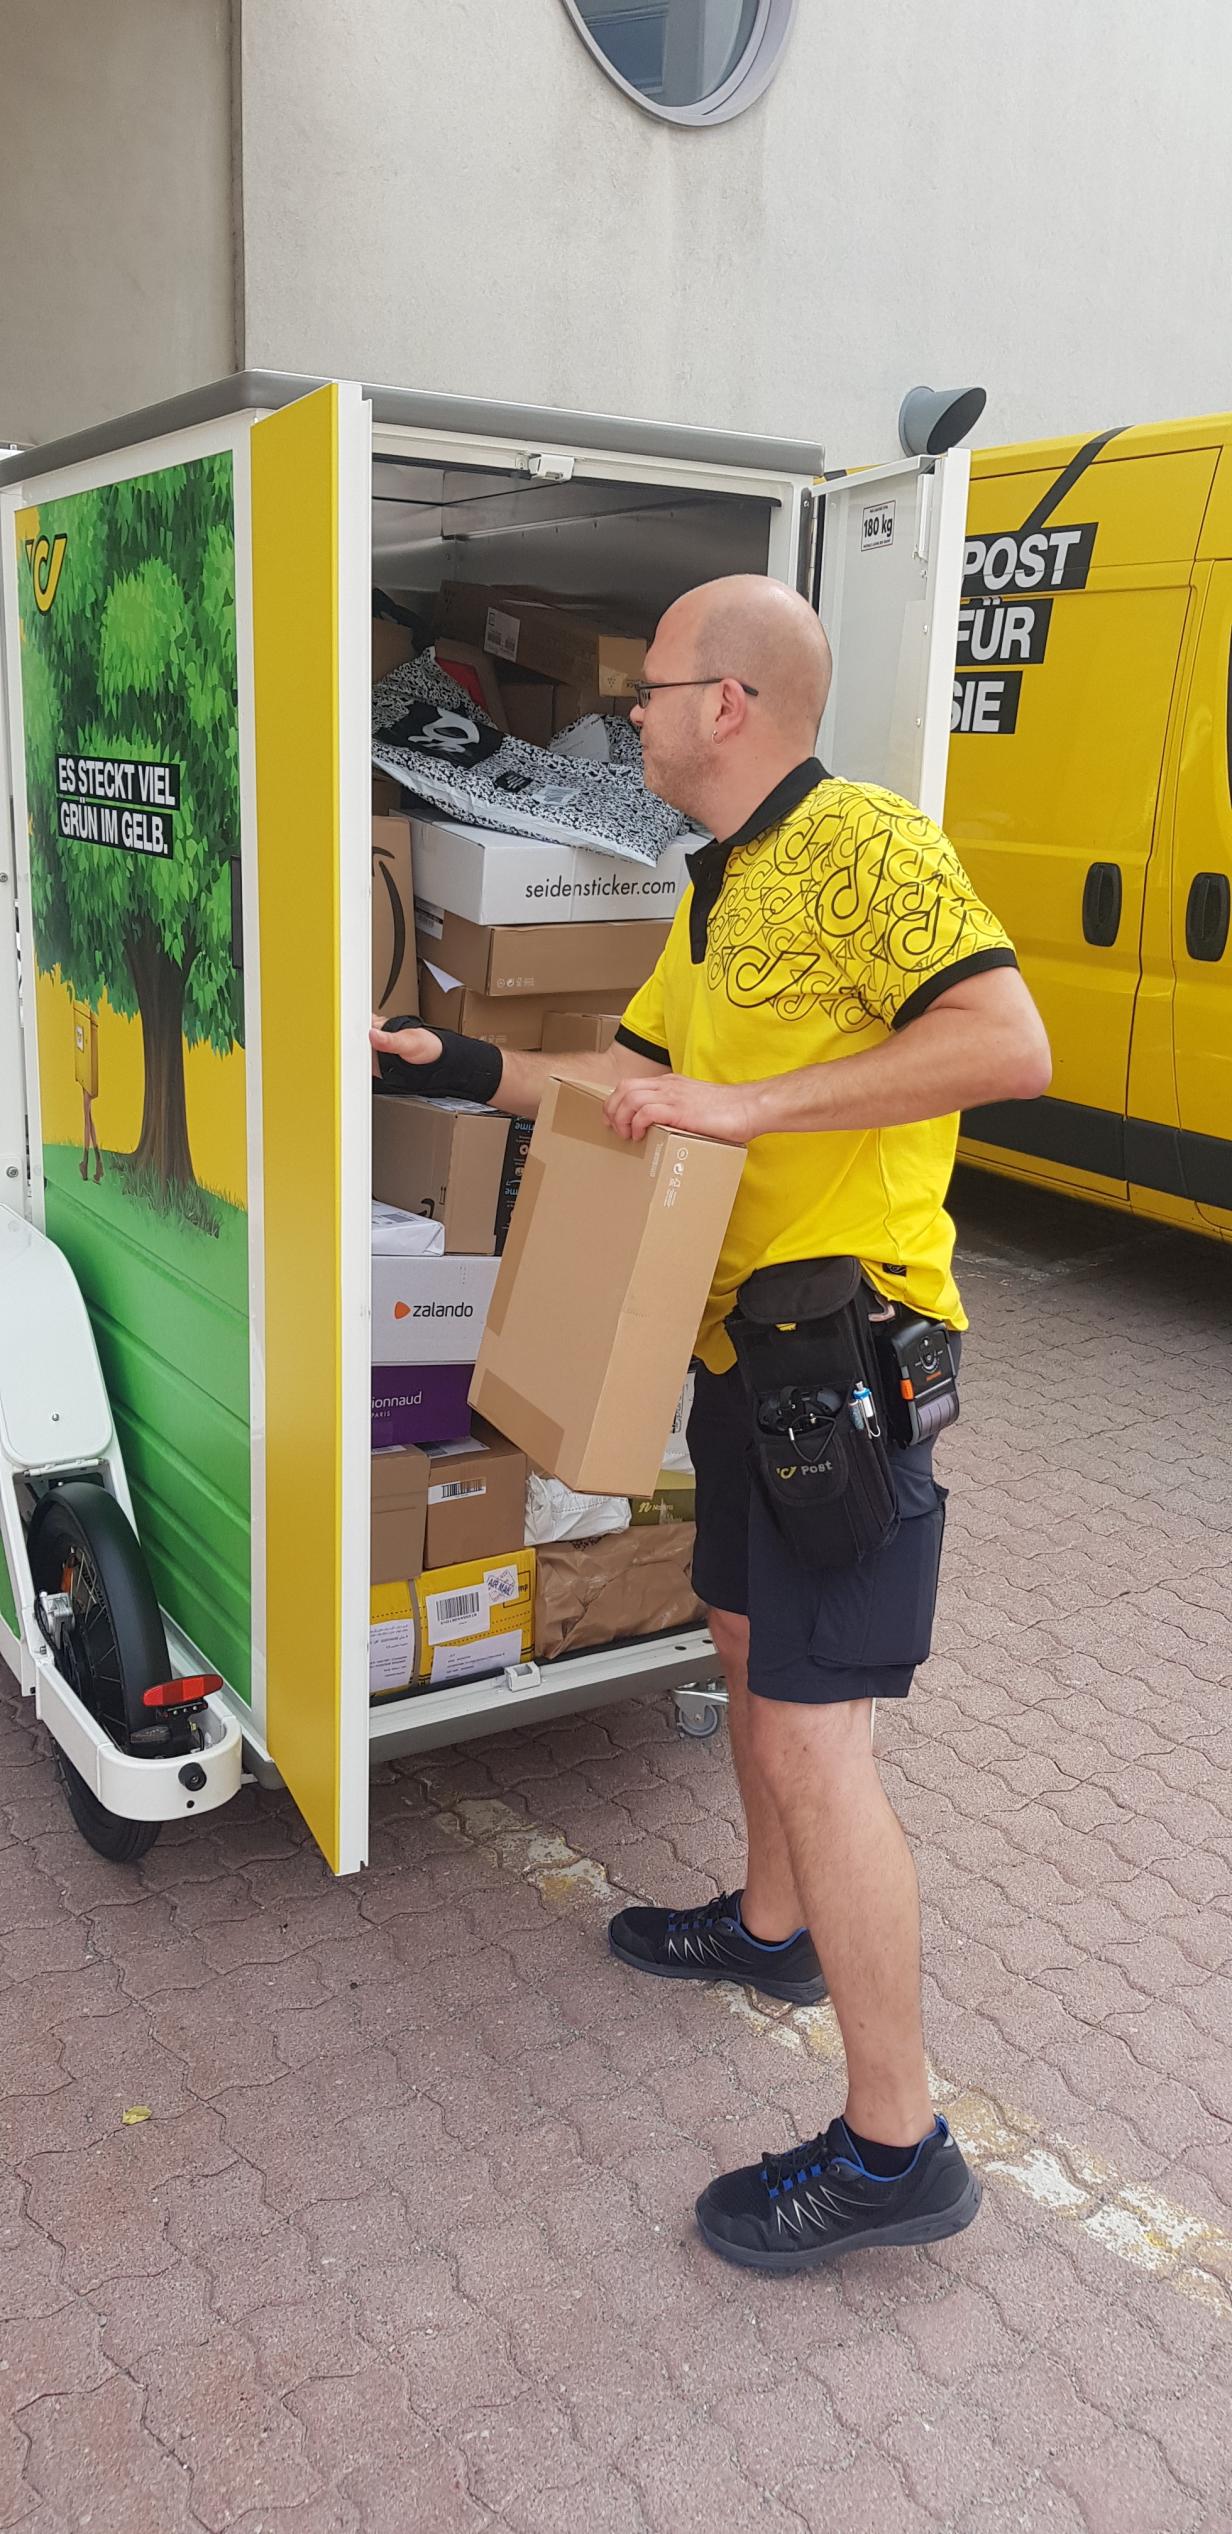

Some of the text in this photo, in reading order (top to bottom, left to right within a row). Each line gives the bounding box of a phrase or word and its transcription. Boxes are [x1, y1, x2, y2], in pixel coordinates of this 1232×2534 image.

[864, 514, 893, 538] 180 kg
[961, 530, 1082, 591] POST
[58, 757, 176, 806] ES STECKT VIEL
[60, 797, 169, 855] GRÜN IM GELB.
[525, 873, 676, 898] seidensticker.com
[412, 1301, 474, 1318] zalando
[371, 1391, 422, 1409] ionnaud
[801, 1460, 833, 1476] Post
